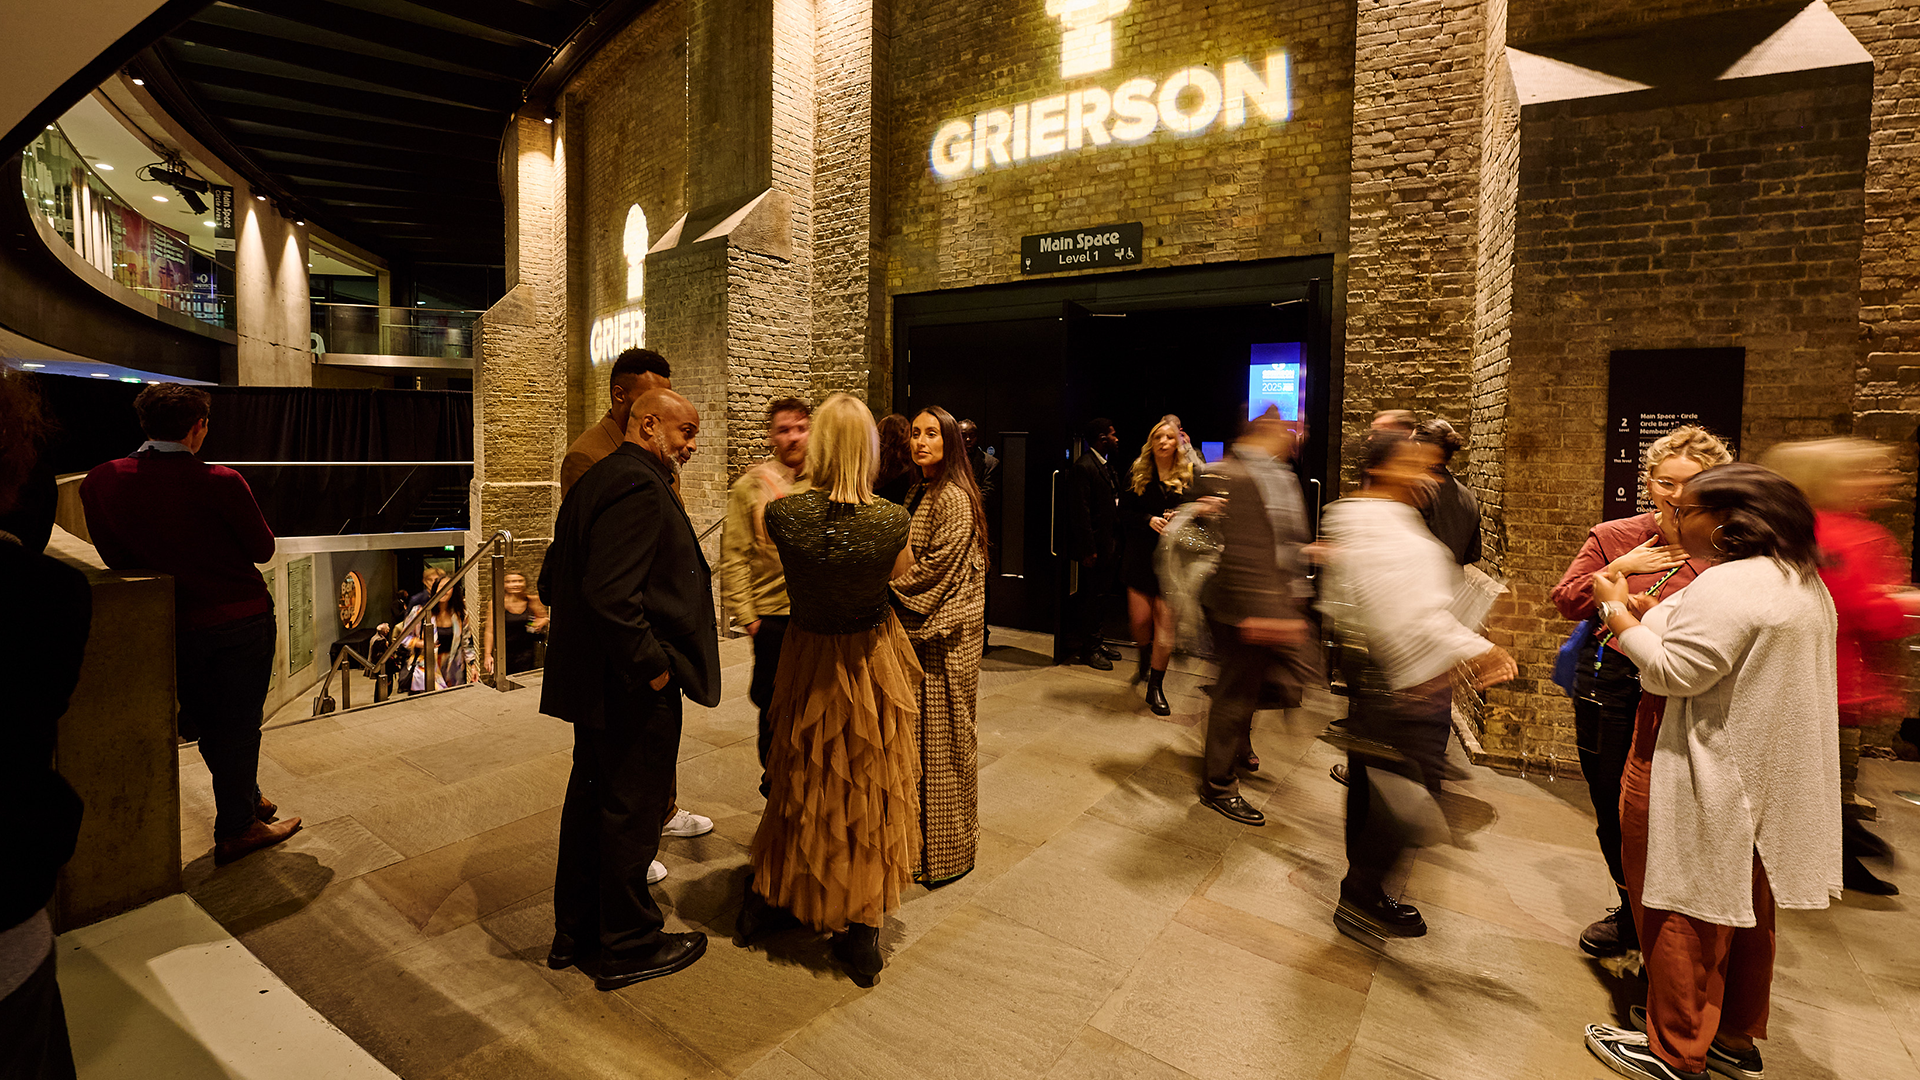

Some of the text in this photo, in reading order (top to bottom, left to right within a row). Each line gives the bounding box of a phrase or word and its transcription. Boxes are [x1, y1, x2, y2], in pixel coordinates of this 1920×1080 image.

[930, 48, 1293, 178] GRIERSON
[223, 190, 232, 207] Main
[222, 208, 232, 229] Space
[1039, 231, 1120, 253] Main Space
[1059, 250, 1099, 265] Level 1
[590, 309, 646, 366] GRIER
[1262, 383, 1282, 391] 2025
[1621, 417, 1628, 427] 2
[1620, 448, 1626, 458] 1
[1617, 487, 1625, 496] 0
